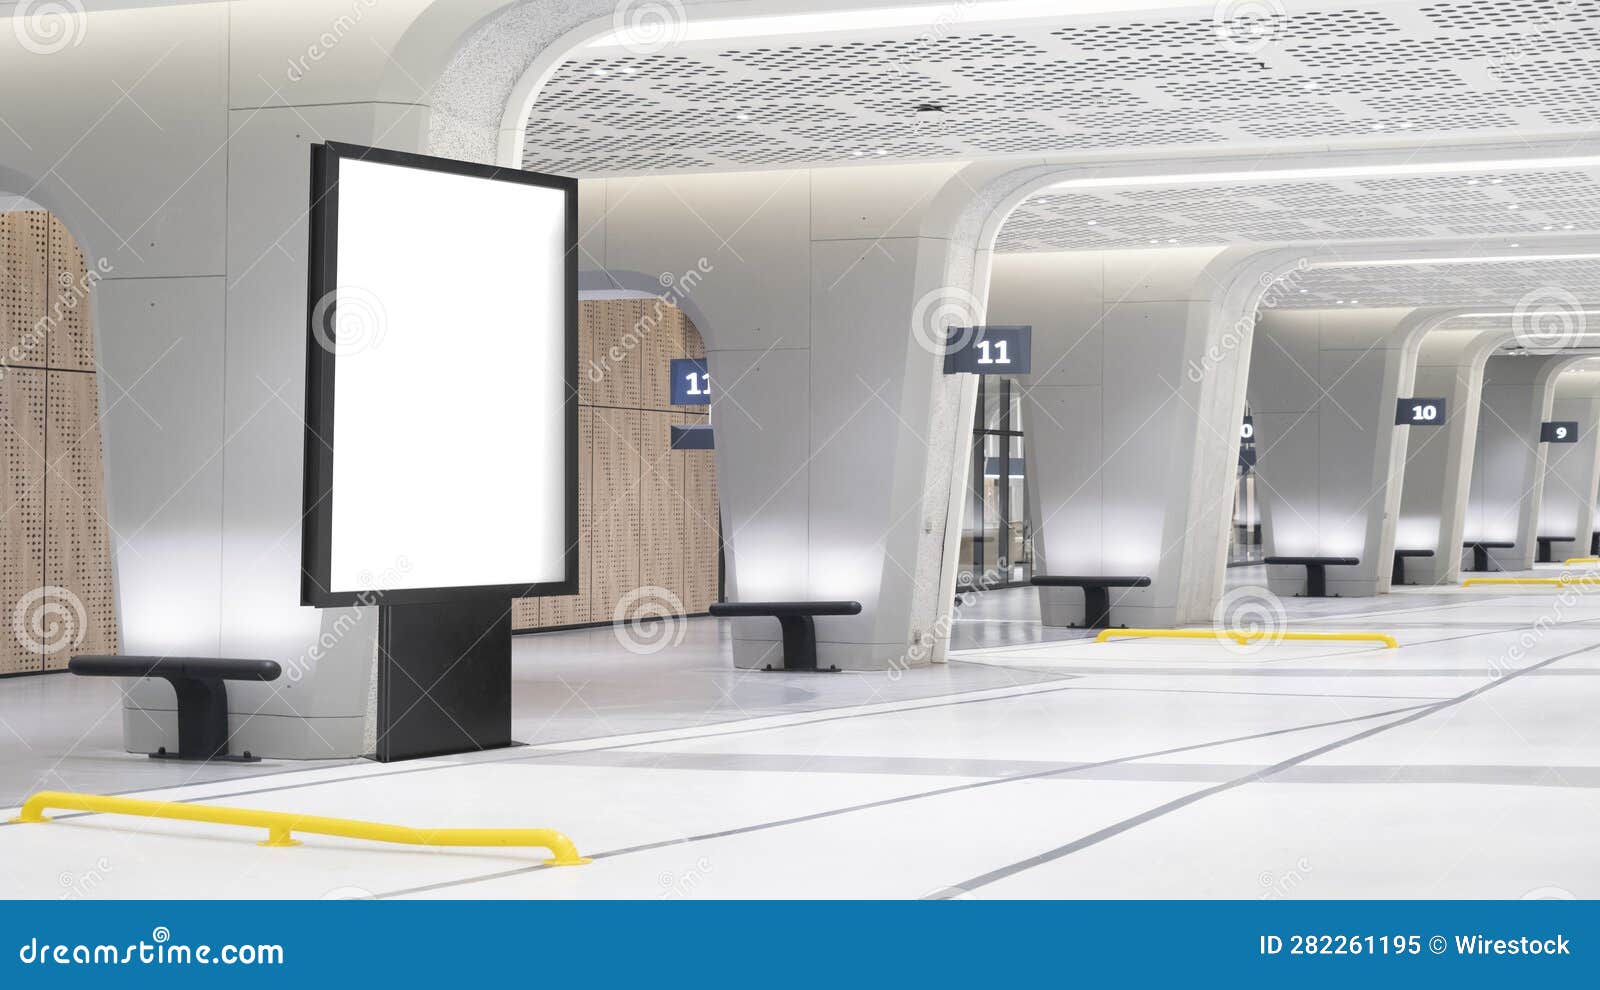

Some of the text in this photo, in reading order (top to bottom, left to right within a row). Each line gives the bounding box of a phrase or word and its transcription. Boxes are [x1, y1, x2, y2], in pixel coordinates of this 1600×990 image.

[977, 340, 1011, 364] 11
[1412, 405, 1437, 420] 10
[1556, 426, 1567, 439] 9
